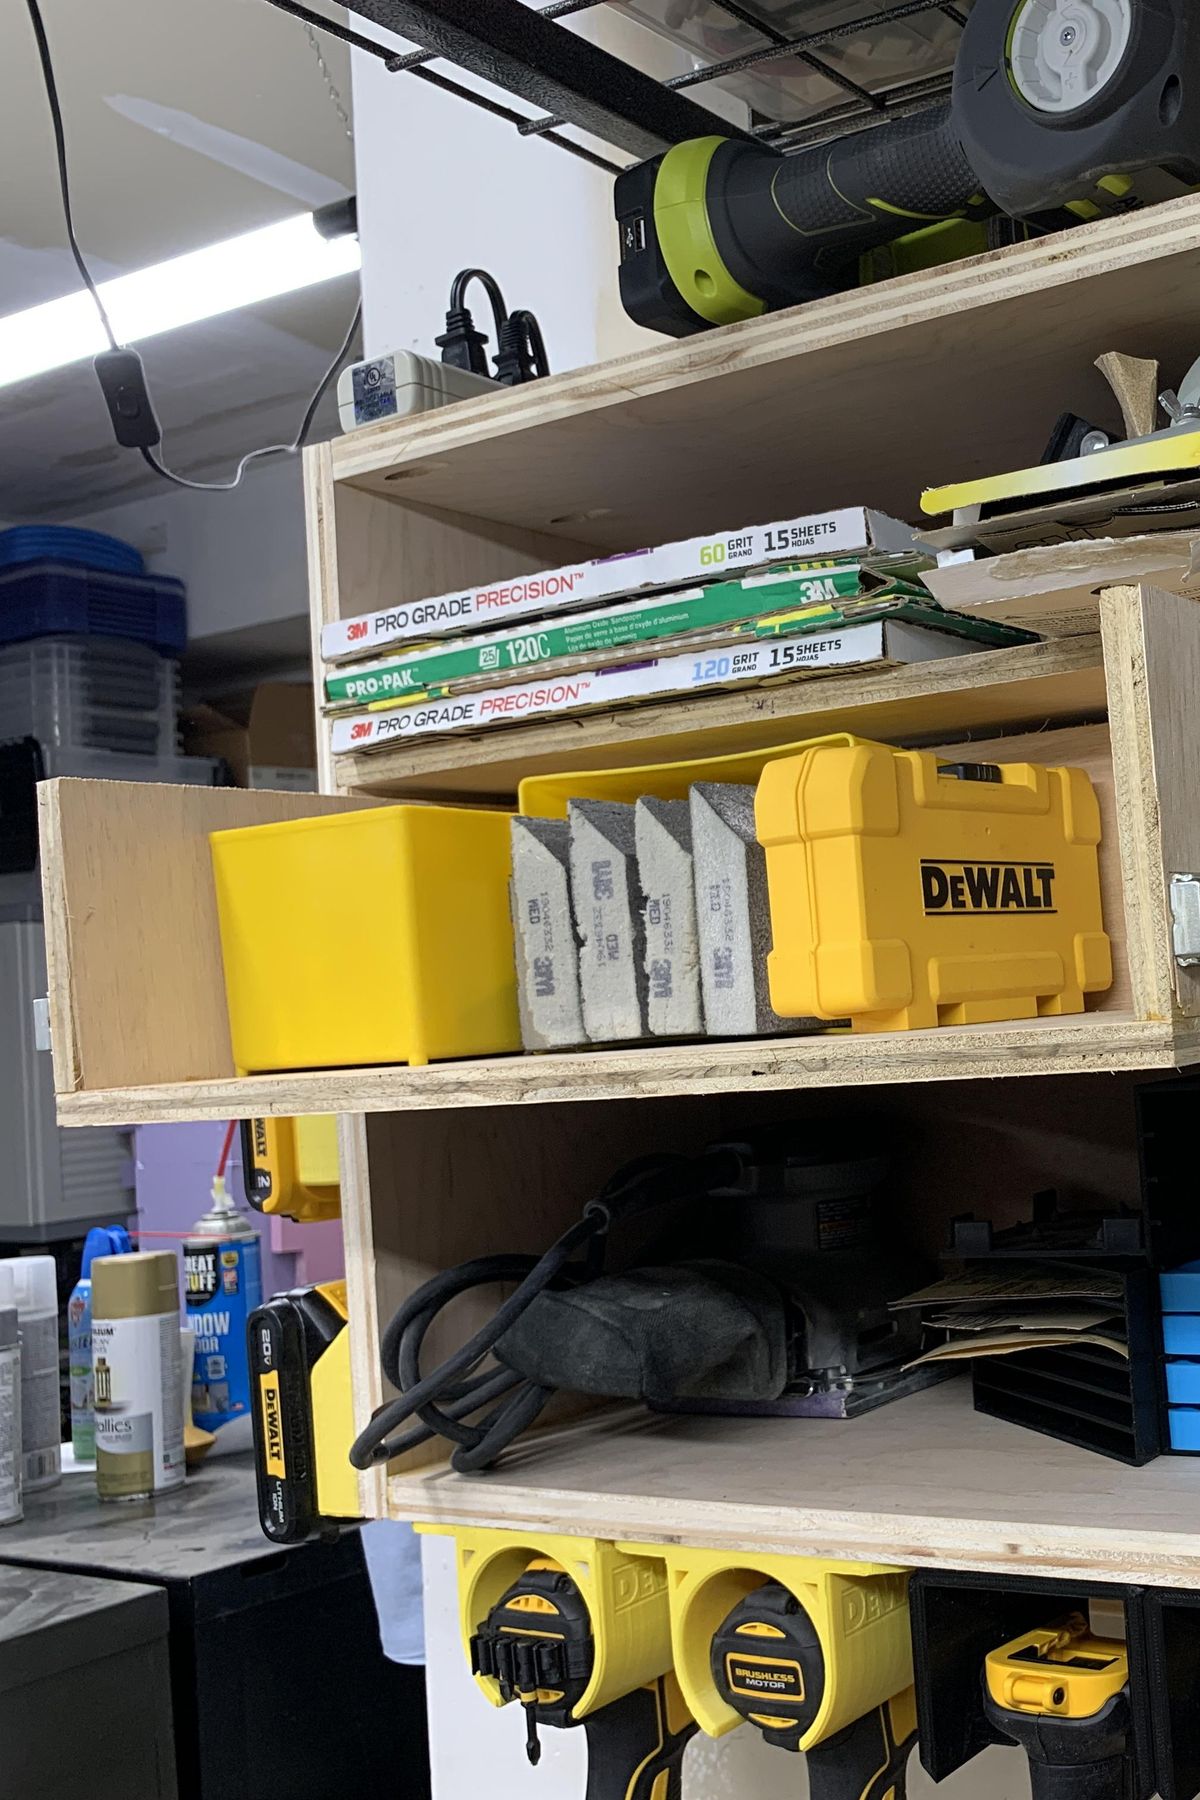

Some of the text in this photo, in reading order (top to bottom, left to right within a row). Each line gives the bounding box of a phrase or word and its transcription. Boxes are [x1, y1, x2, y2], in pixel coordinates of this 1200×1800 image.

[700, 521, 837, 566] 60 GRIT 15 SHEETS
[728, 548, 753, 560] GRAND
[791, 537, 816, 548] HOJAS
[800, 577, 840, 604] 3M
[347, 621, 368, 641] 3M
[375, 611, 409, 635] PRO
[411, 597, 472, 624] GRADE
[482, 633, 551, 665] 25 120C
[691, 639, 842, 682] 120 GRIT 15 SHEETS
[795, 653, 819, 663] HOJAS
[731, 663, 757, 675] GRAND
[351, 721, 373, 740] 3M
[377, 714, 411, 736] PRO
[414, 703, 474, 728] GRADE
[529, 898, 541, 925] MED
[255, 1117, 267, 1157] WALT
[184, 1254, 216, 1273] REAT
[186, 1271, 217, 1293] TUFF
[96, 1419, 132, 1434] allics
[266, 1388, 282, 1461] DEWALT
[734, 1667, 796, 1683] BRUSHLESS
[745, 1678, 786, 1689] MOTOR
